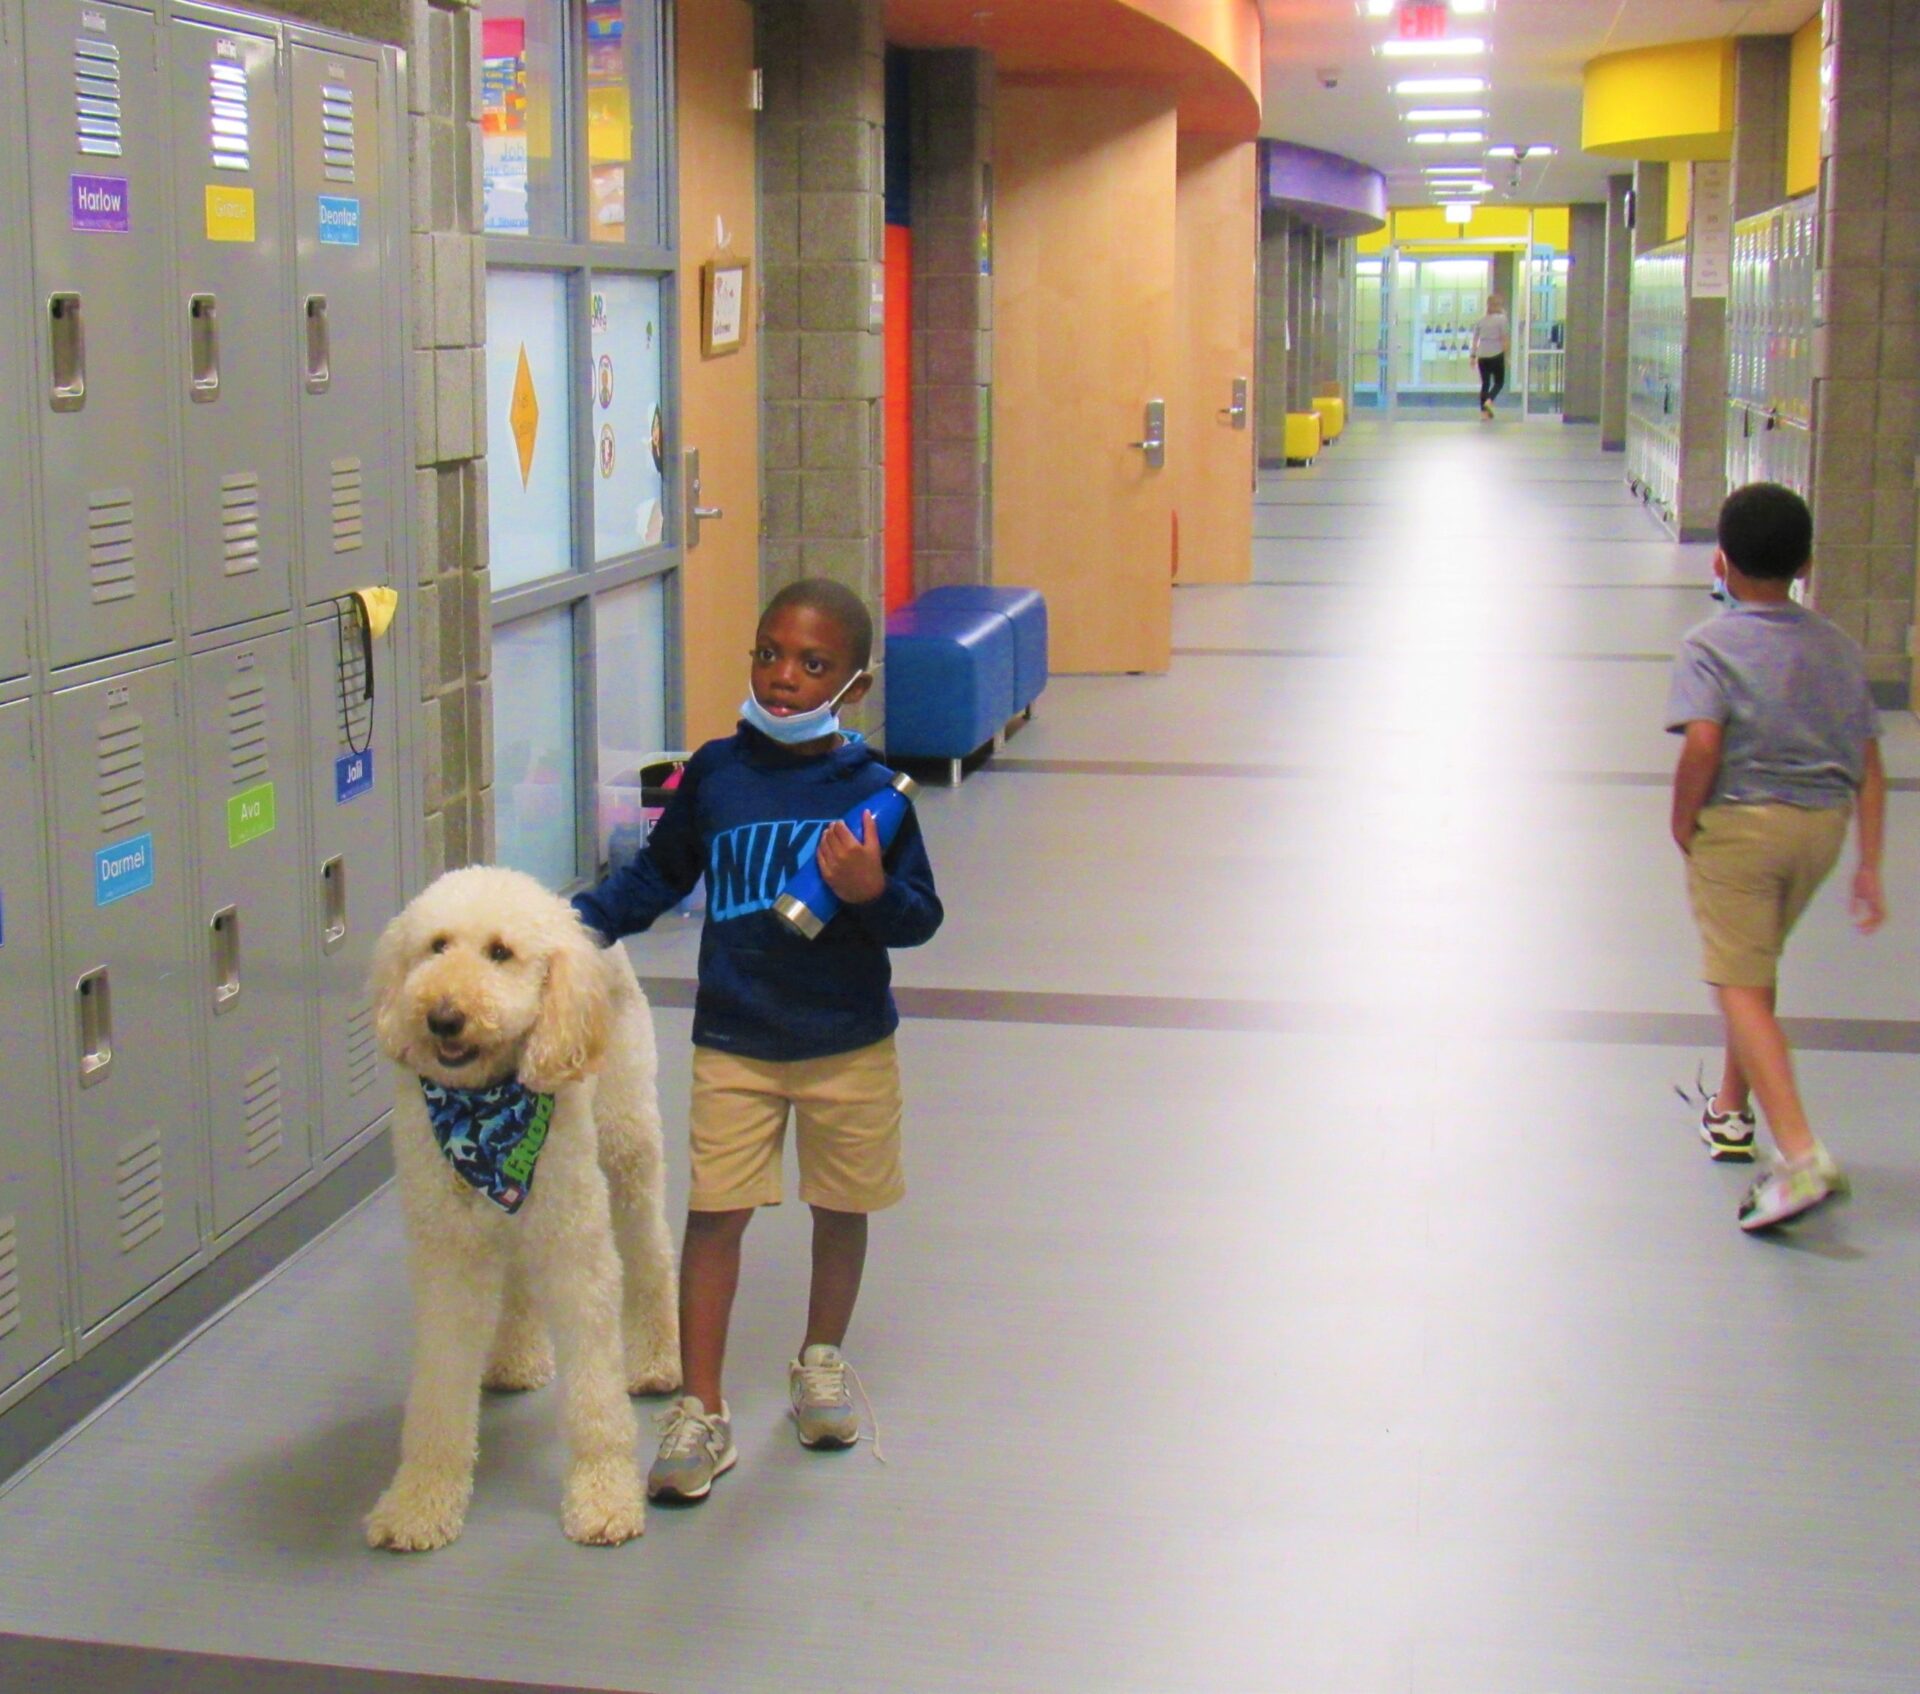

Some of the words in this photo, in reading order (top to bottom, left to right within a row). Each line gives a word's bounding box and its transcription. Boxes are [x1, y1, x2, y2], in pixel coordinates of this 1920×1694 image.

[78, 186, 121, 212] Harlow
[320, 204, 358, 227] Deontae
[240, 801, 261, 822] Ava
[101, 844, 146, 881] Darmel
[711, 818, 845, 923] NIK
